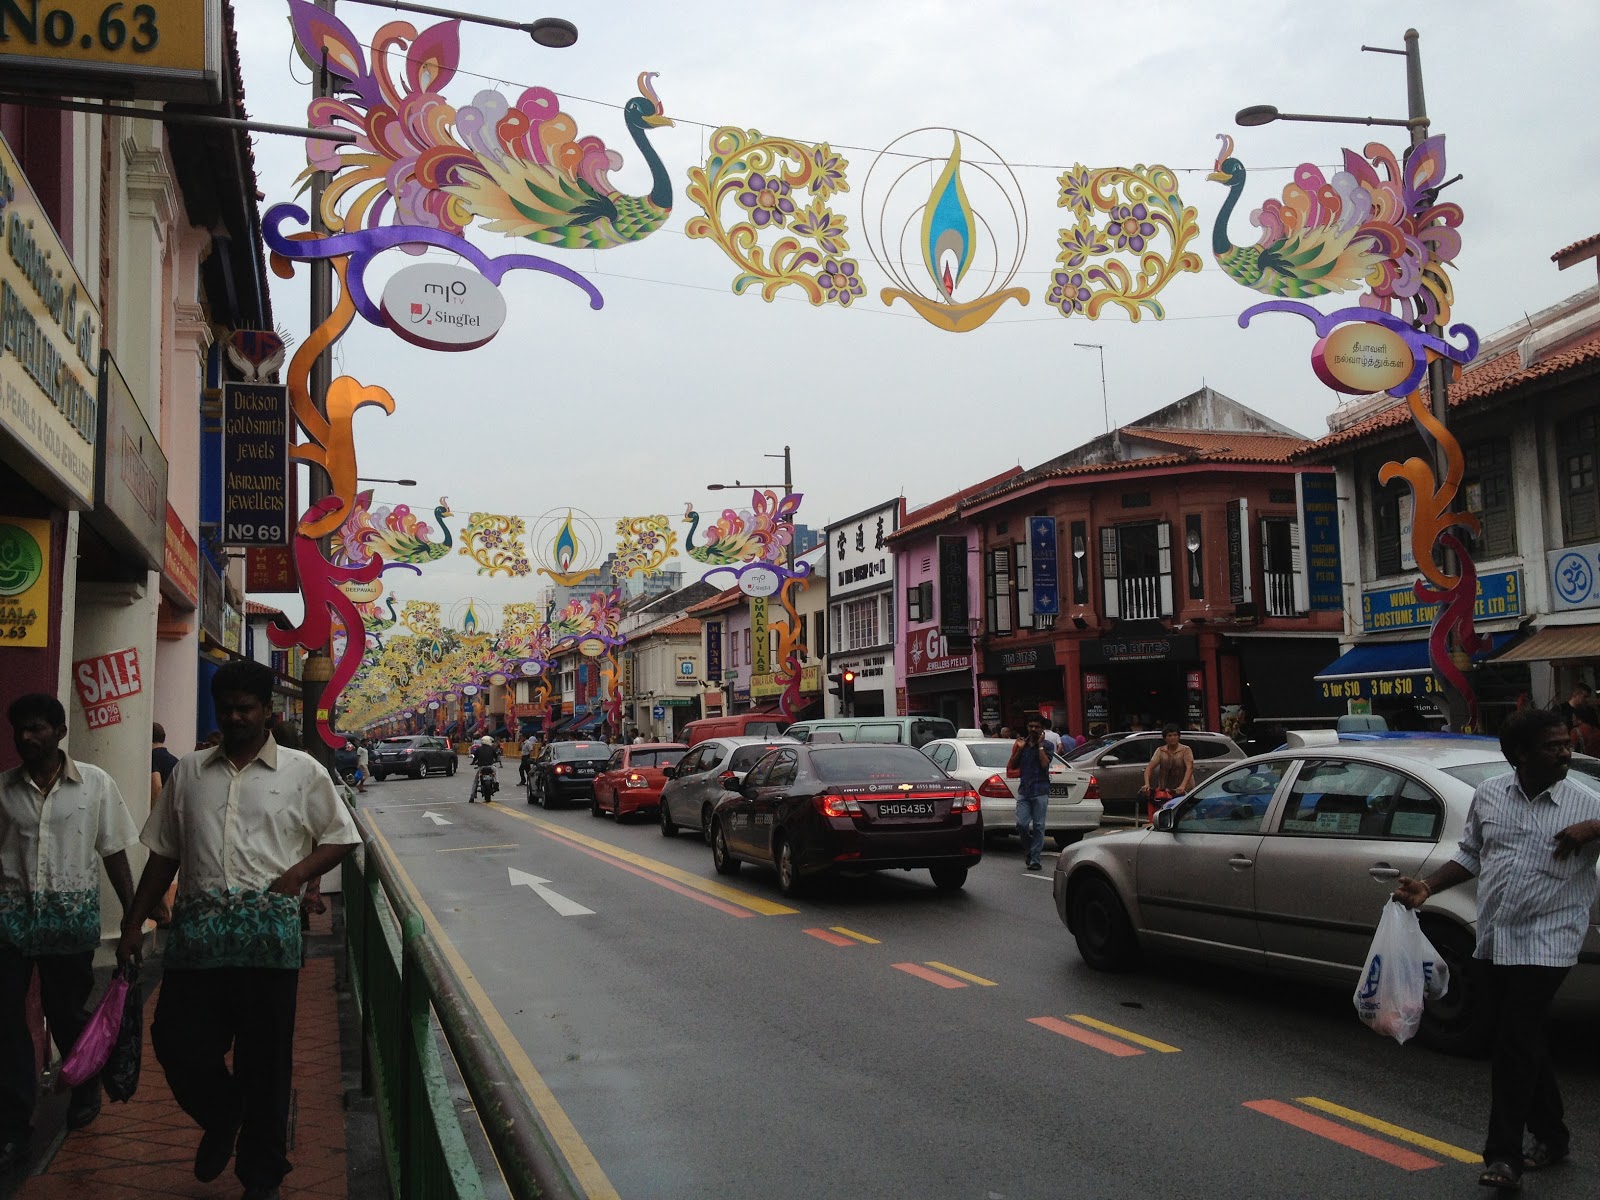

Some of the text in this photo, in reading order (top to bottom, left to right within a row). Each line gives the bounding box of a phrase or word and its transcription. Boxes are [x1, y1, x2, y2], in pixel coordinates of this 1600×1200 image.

[0, 0, 159, 53] No.63
[435, 310, 480, 328] SingTel
[6, 378, 35, 435] PEARLS
[37, 413, 42, 442] &
[43, 419, 61, 460] GOLD
[61, 438, 92, 491] JEWELLERY
[257, 525, 281, 541] 69
[1506, 574, 1516, 594] 3
[1363, 596, 1371, 613] 3
[1373, 609, 1413, 628] COSTUME
[1488, 596, 1505, 614] LTD
[754, 596, 766, 672] OMALA VILAS
[1103, 641, 1171, 656] BIG BITES
[950, 657, 959, 668] PTE
[959, 655, 968, 666] LTD
[78, 651, 140, 703] SALE
[1424, 676, 1433, 693] 3
[1322, 681, 1361, 698] 3 for $10
[1371, 677, 1413, 696] 3 for $10
[88, 703, 118, 727] 10%
[879, 804, 933, 815] SHD6436X
